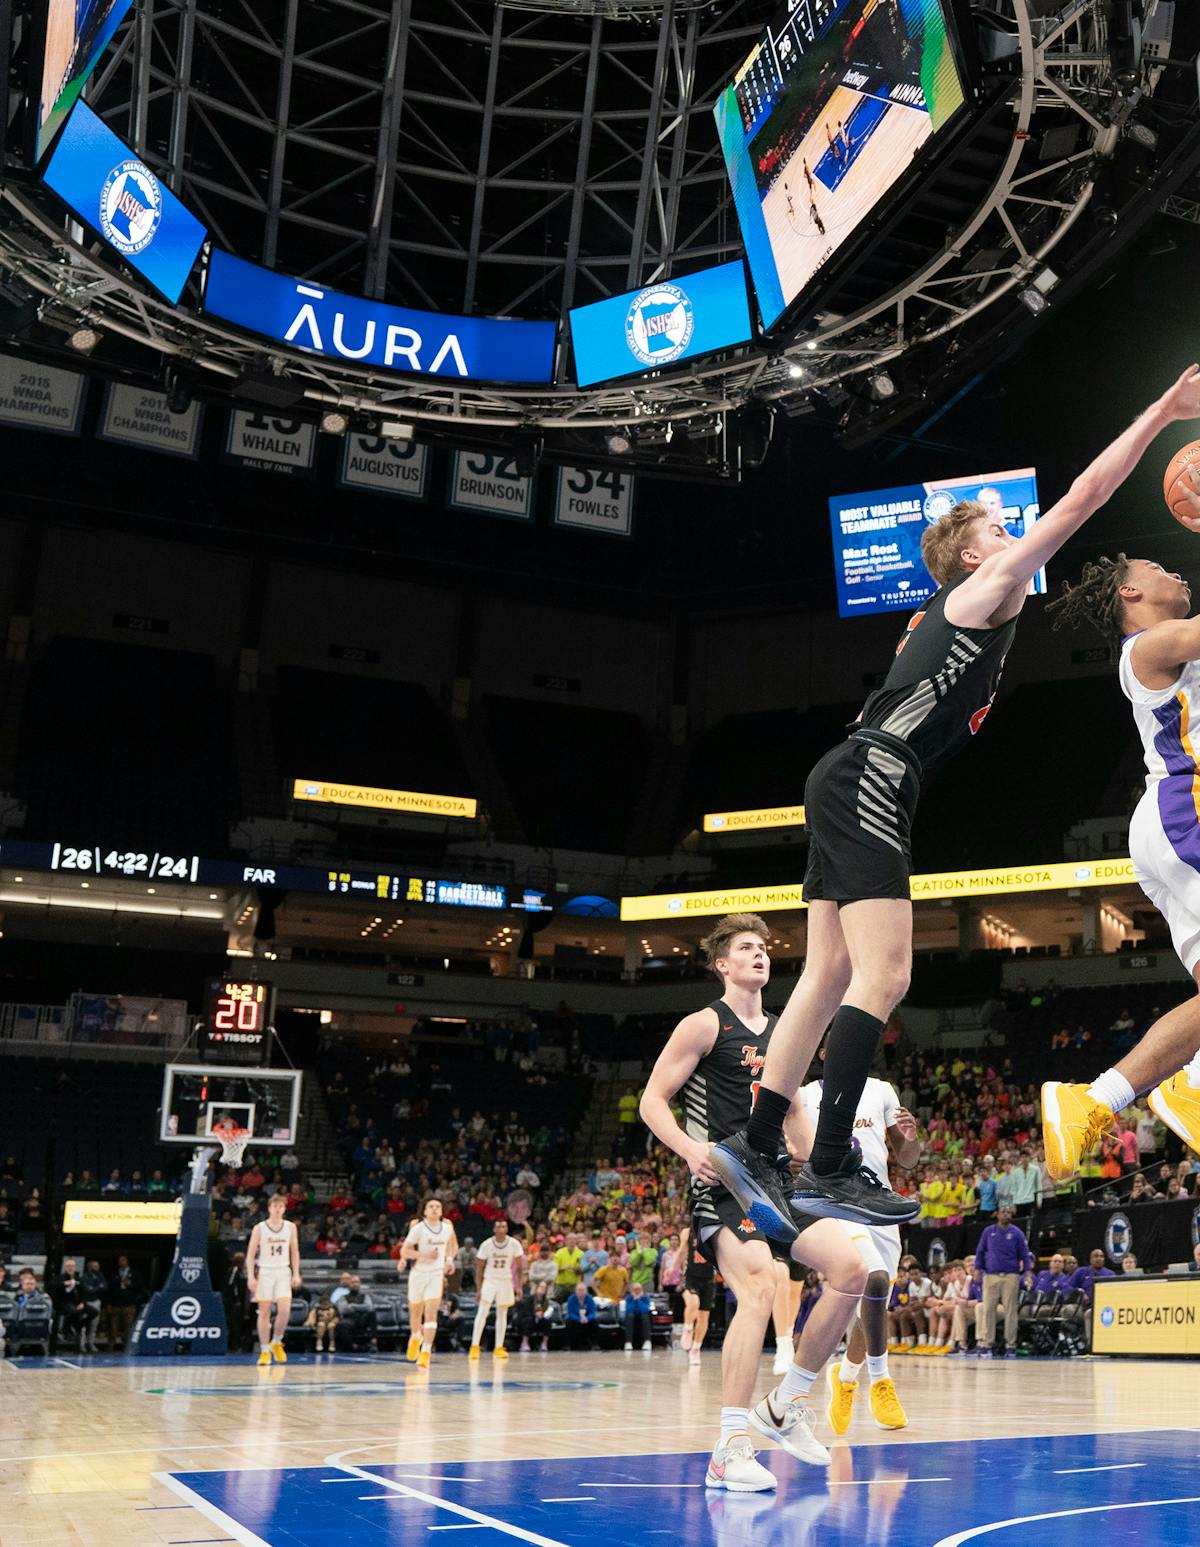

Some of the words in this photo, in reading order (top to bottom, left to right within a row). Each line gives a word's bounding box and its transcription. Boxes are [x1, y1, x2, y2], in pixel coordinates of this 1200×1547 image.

[13, 386, 51, 402] WNBA
[0, 397, 69, 418] HAMPIONS
[135, 408, 171, 424] WNBA
[113, 415, 188, 442] CHAMPIONS
[242, 433, 300, 457] WHALEN
[350, 456, 419, 482] AUGUSTUS
[459, 477, 524, 502] BRUNSON
[568, 498, 619, 519] FOWLES
[840, 509, 868, 523] MOST
[870, 500, 921, 516] VALUABLE
[841, 515, 897, 534] TEAMMATE
[842, 548, 868, 560] Max
[869, 543, 898, 556] Rost
[301, 787, 393, 804] EDUCATION
[397, 796, 466, 811] MINNESOTA
[727, 811, 788, 826] EDUCATION
[61, 848, 92, 870] 26
[104, 850, 148, 871] 4:22
[158, 856, 188, 878] 24
[1095, 864, 1134, 878] EDUC
[243, 867, 276, 884] FAR
[912, 878, 964, 892] CATION
[968, 871, 1052, 888] MINNESOTA
[686, 894, 764, 910] EDUCATION
[766, 892, 800, 903] MINN
[1130, 956, 1148, 968] 126
[225, 983, 264, 1003] 4:21
[215, 999, 258, 1030] 20
[223, 1033, 262, 1043] TISSOT
[270, 1245, 283, 1256] 14
[1118, 1307, 1198, 1326] EDUCATION
[146, 1327, 221, 1339] CFMOTO
